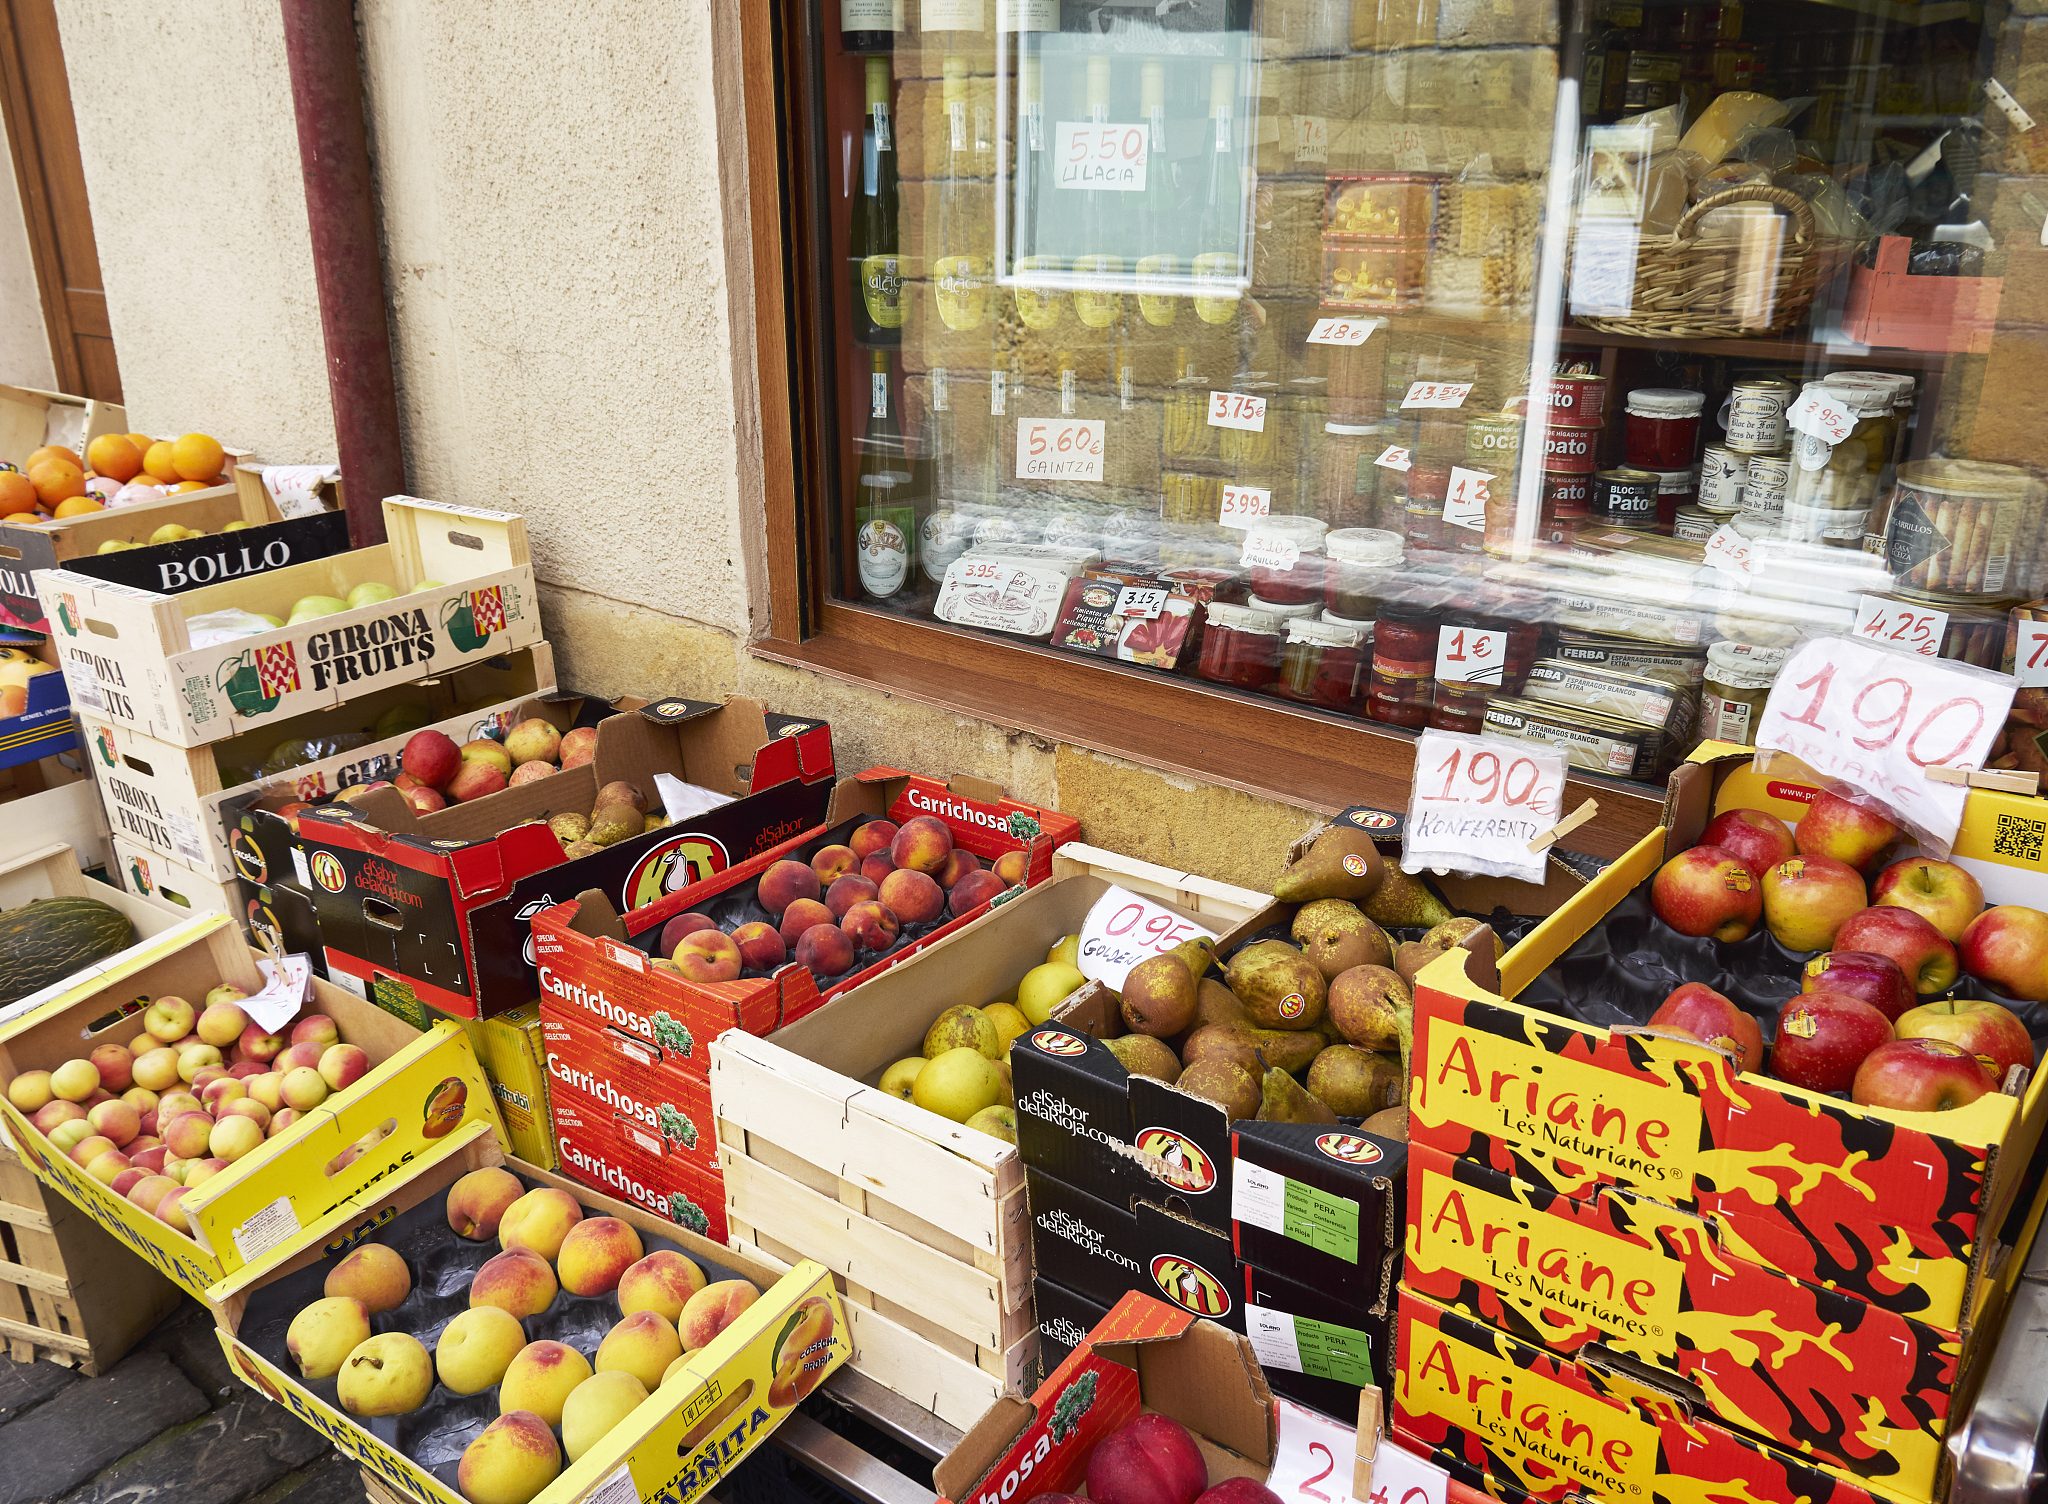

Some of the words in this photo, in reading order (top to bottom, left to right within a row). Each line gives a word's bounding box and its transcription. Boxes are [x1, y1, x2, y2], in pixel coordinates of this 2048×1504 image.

[1062, 164, 1135, 184] ULACIA
[1319, 324, 1363, 340] 18€
[1214, 394, 1266, 420] 3.75€
[1805, 401, 1847, 439] 3.95€
[1029, 426, 1103, 457] 5.60€
[1483, 434, 1520, 449] oca
[1544, 439, 1587, 456] pato
[1026, 459, 1095, 475] GAINTZA
[1552, 486, 1586, 501] ato
[1608, 494, 1649, 512] Pato
[1610, 485, 1635, 495] BLOC
[1223, 491, 1269, 516] 3.99€
[1253, 537, 1294, 561] 3.10€
[1709, 535, 1754, 572] 3.15€
[157, 541, 292, 590] BOLLO
[965, 563, 1004, 580] 3.95€
[0, 568, 38, 600] OLL
[1075, 613, 1105, 625] Piquillo
[307, 608, 432, 662] GIRONA
[1863, 609, 1937, 657] 4.25€
[311, 635, 437, 693] FRUITS
[1564, 648, 1605, 661] FERBA
[1610, 654, 1653, 665] ESPÁRRAGOS
[1652, 657, 1683, 667] BLANCOS
[1610, 660, 1631, 668] EXTRA
[1528, 667, 1561, 682] FERBA
[1564, 683, 1585, 692] EXTRA
[1566, 676, 1607, 691] ESPÁRRAGOS
[1607, 685, 1637, 697] BLANCOS
[20, 711, 44, 722] BENIEL
[1485, 710, 1522, 729] FERBA
[1526, 729, 1546, 740] EXTRA
[1528, 723, 1569, 739] ESPÁRRAGOS
[1569, 732, 1600, 745] BLANCOS
[1421, 747, 1556, 817] 1.90€
[108, 776, 164, 820] GIRONA
[907, 788, 1008, 834] Carrichosa
[116, 805, 172, 850] FRUITS
[363, 858, 398, 885] elSabor
[536, 934, 558, 943] SPECIAL
[1105, 903, 1195, 954] 0.95
[536, 945, 564, 954] SELECTION
[1083, 938, 1143, 966] GOLDEN
[539, 966, 653, 1040] Carrichosa
[544, 1022, 565, 1031] SPECIAL
[544, 1032, 572, 1041] SELECTION
[547, 1052, 658, 1129] Carrichosa
[1439, 1036, 1671, 1158] Ariane
[556, 1108, 577, 1118] SPECIAL
[1032, 1089, 1090, 1123] elSabor
[557, 1117, 584, 1128] SELECTION
[1018, 1095, 1126, 1150] delaRioja.com
[1502, 1108, 1536, 1136] Les
[559, 1136, 670, 1216] Carrichosa
[65, 1166, 124, 1216] FRUTAS
[1286, 1191, 1309, 1205] Producto
[1313, 1202, 1337, 1217] PERA
[37, 1148, 200, 1293] ENCARNITA
[1049, 1208, 1106, 1244] elSabor
[1286, 1201, 1308, 1215] Variedad
[1313, 1213, 1347, 1231] Conferencia
[1036, 1213, 1141, 1274] delaRioja.com
[1285, 1224, 1294, 1232] La
[1294, 1227, 1311, 1239] Rioja
[1431, 1189, 1657, 1315] Ariane
[1491, 1259, 1525, 1285] Les
[799, 1335, 839, 1361] COSECHA
[1297, 1330, 1320, 1340] Producto
[1324, 1334, 1347, 1347] PERA
[803, 1350, 835, 1373] PROPIA
[1303, 1361, 1312, 1369] La
[1312, 1363, 1328, 1373] Rioja
[1419, 1341, 1634, 1472] Ariane
[1476, 1409, 1508, 1436] Les
[335, 1417, 414, 1477] FRUTAS
[724, 1446, 744, 1468] Murcia
